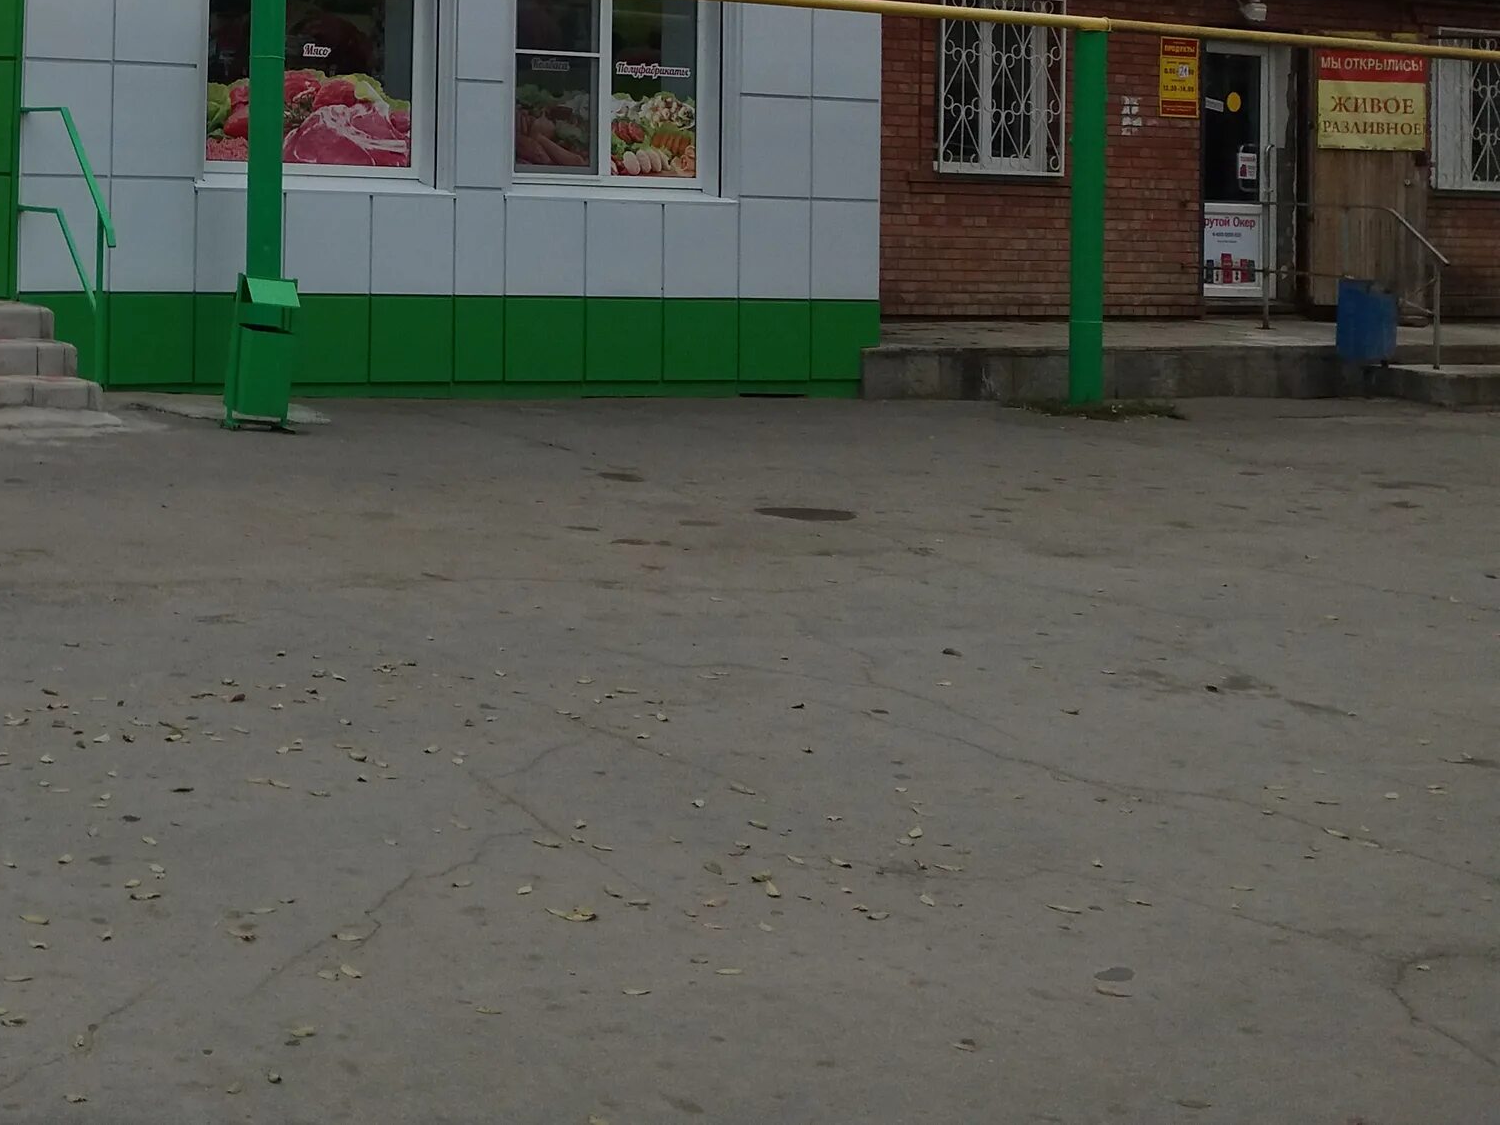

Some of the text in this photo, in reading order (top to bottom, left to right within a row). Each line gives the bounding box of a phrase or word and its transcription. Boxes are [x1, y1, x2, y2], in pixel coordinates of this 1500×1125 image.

[303, 43, 331, 57] Мясо
[616, 62, 690, 79] Полуфабрикаты
[1321, 56, 1423, 72] МЫ ОТКРЫЛИСЬ!
[1331, 96, 1415, 114] ЖИВОЕ
[1323, 120, 1423, 136] РАЗЛИВНОЕ
[1204, 217, 1230, 229] рутой
